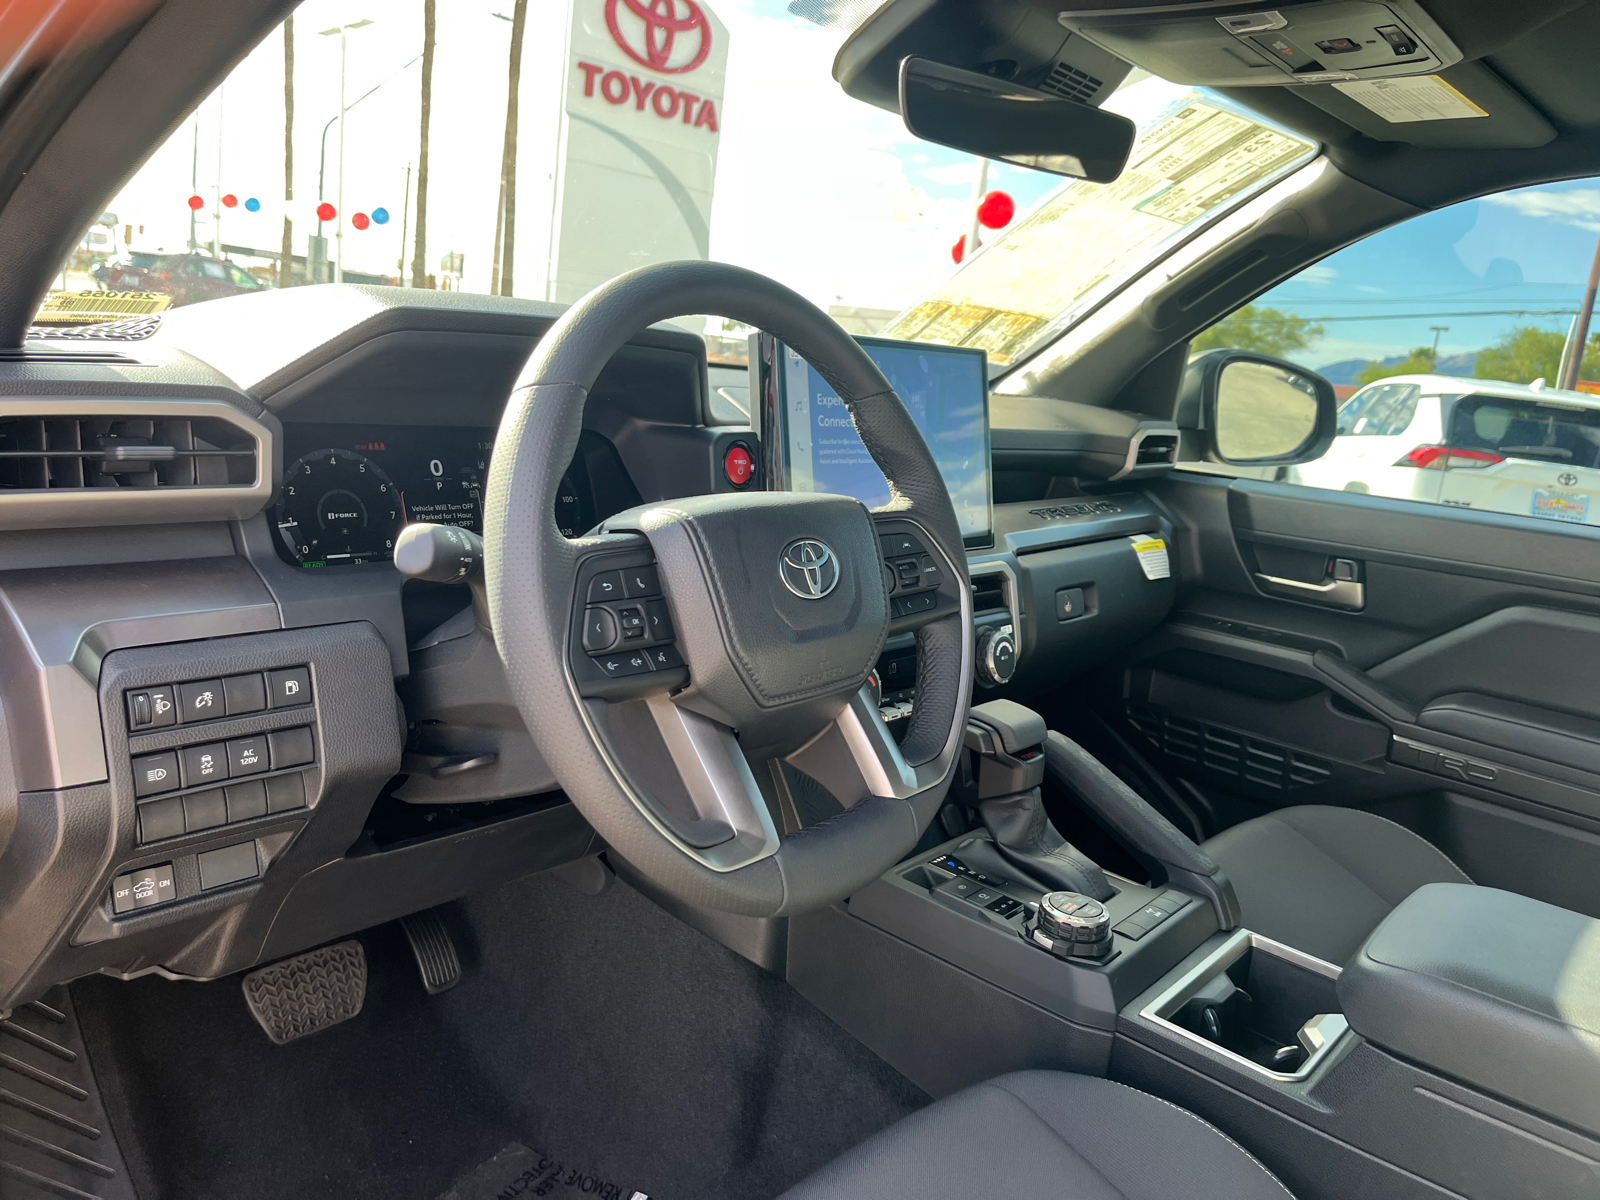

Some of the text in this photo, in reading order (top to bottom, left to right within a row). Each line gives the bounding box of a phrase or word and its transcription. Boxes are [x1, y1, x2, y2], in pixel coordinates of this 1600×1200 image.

[578, 61, 718, 132] TOYOTA
[330, 457, 336, 465] 4
[305, 466, 311, 474] 3
[360, 464, 366, 473] 5
[430, 459, 444, 476] 0
[437, 482, 443, 490] P
[289, 487, 295, 495] 2
[411, 504, 434, 512] Vehicle
[390, 511, 396, 519] 7
[386, 540, 392, 548] 8
[302, 545, 309, 554] 0
[243, 749, 254, 757] AC
[240, 756, 258, 765] 120V
[202, 767, 214, 775] OFF
[159, 879, 170, 888] ON
[117, 889, 130, 897] OFF
[136, 890, 154, 899] DOOR
